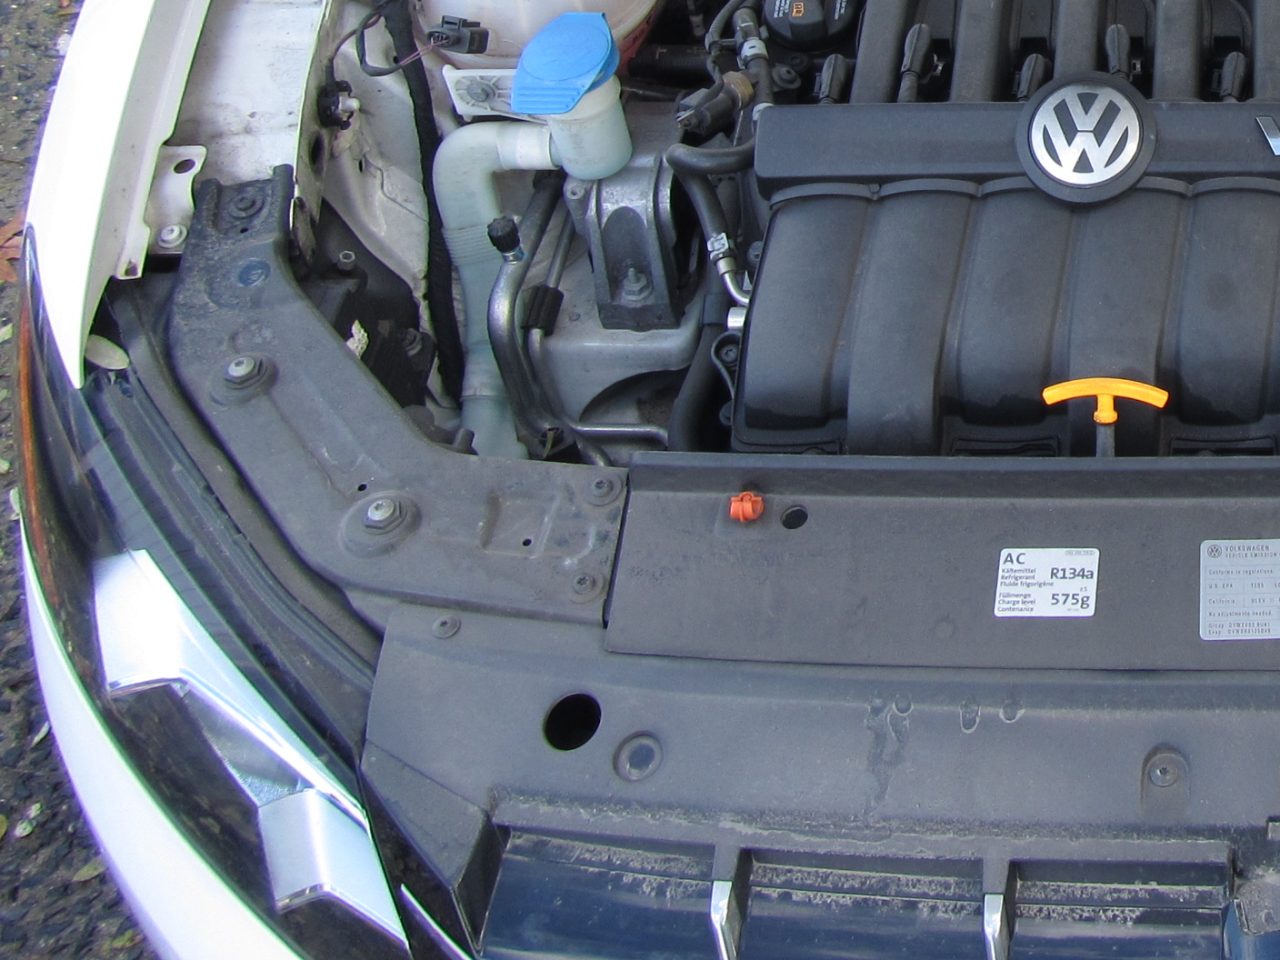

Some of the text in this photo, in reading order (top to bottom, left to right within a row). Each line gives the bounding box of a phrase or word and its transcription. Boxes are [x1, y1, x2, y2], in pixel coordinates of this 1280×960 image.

[1003, 553, 1026, 564] AC
[1050, 567, 1094, 580] R134a
[1051, 593, 1090, 609] 575g
